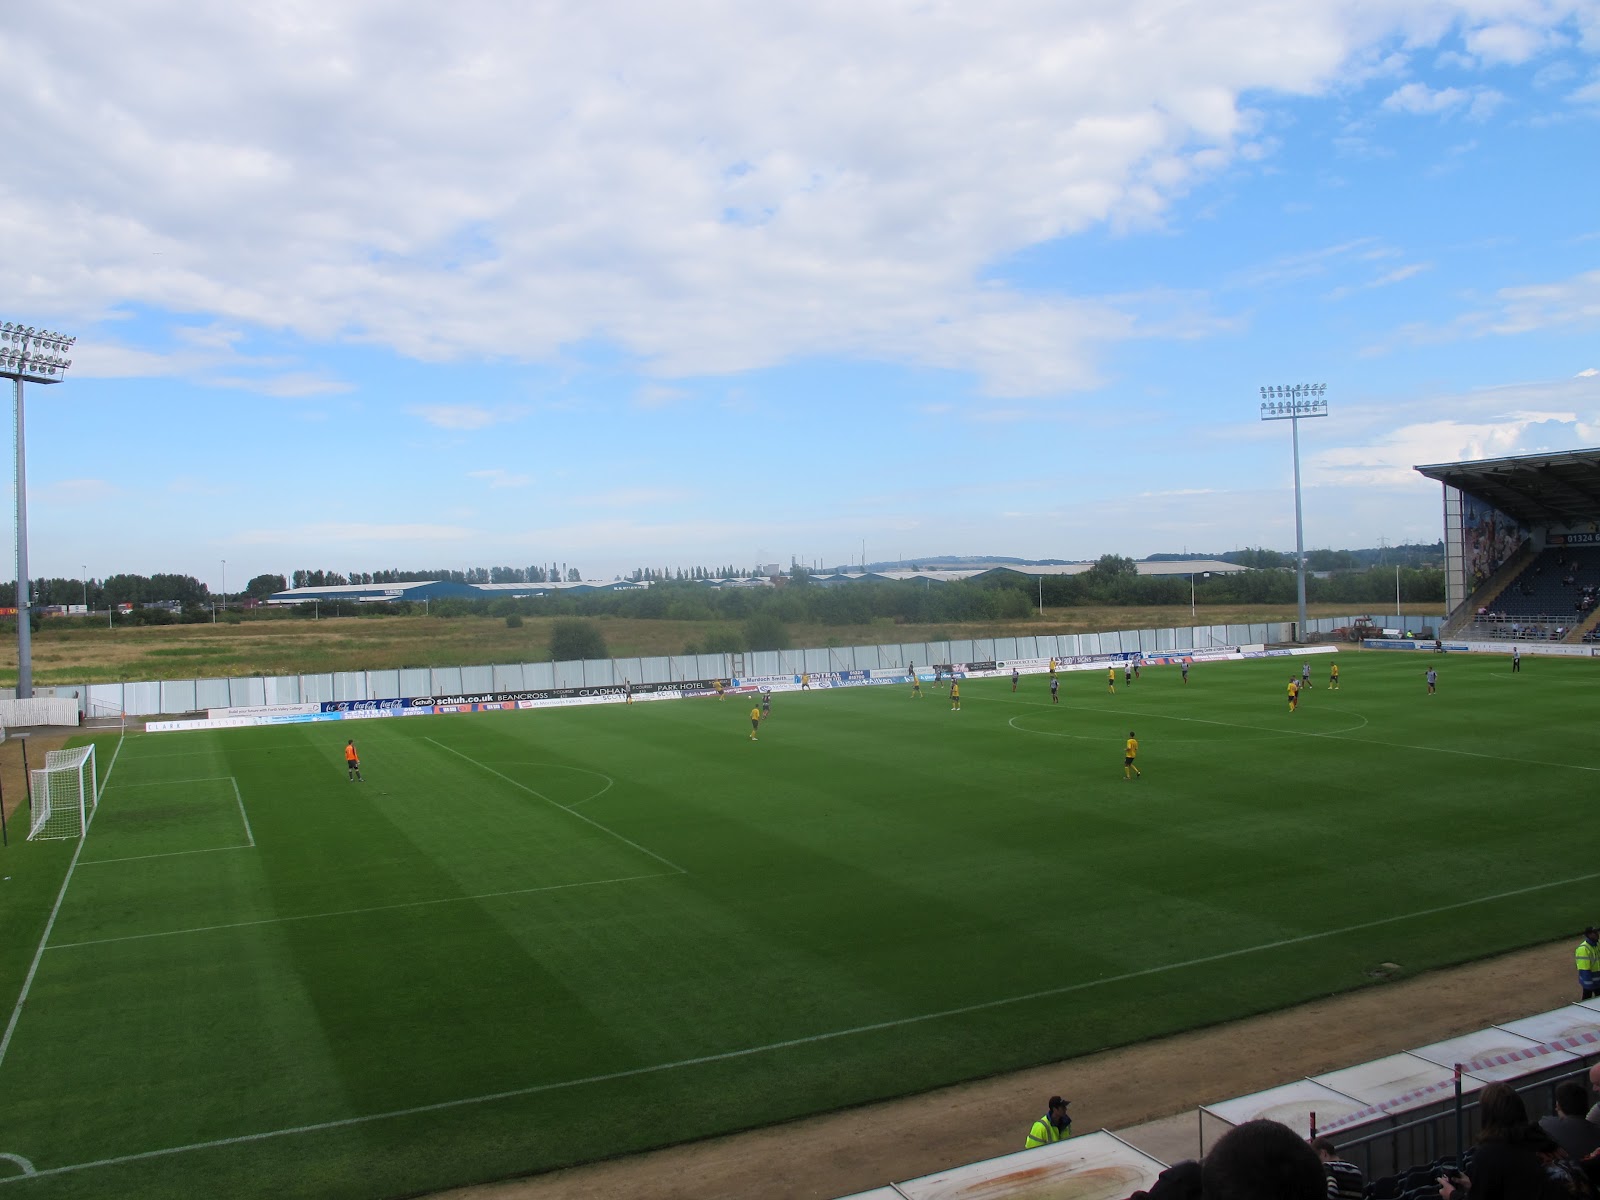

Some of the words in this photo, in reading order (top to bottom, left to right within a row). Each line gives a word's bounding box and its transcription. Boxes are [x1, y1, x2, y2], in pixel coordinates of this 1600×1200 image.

[1567, 534, 1593, 543] 01324
[497, 692, 549, 701] BEANCROSS
[579, 687, 626, 697] CLADHAN
[437, 694, 494, 705] schuh.co.uk
[148, 723, 181, 731] CLARK
